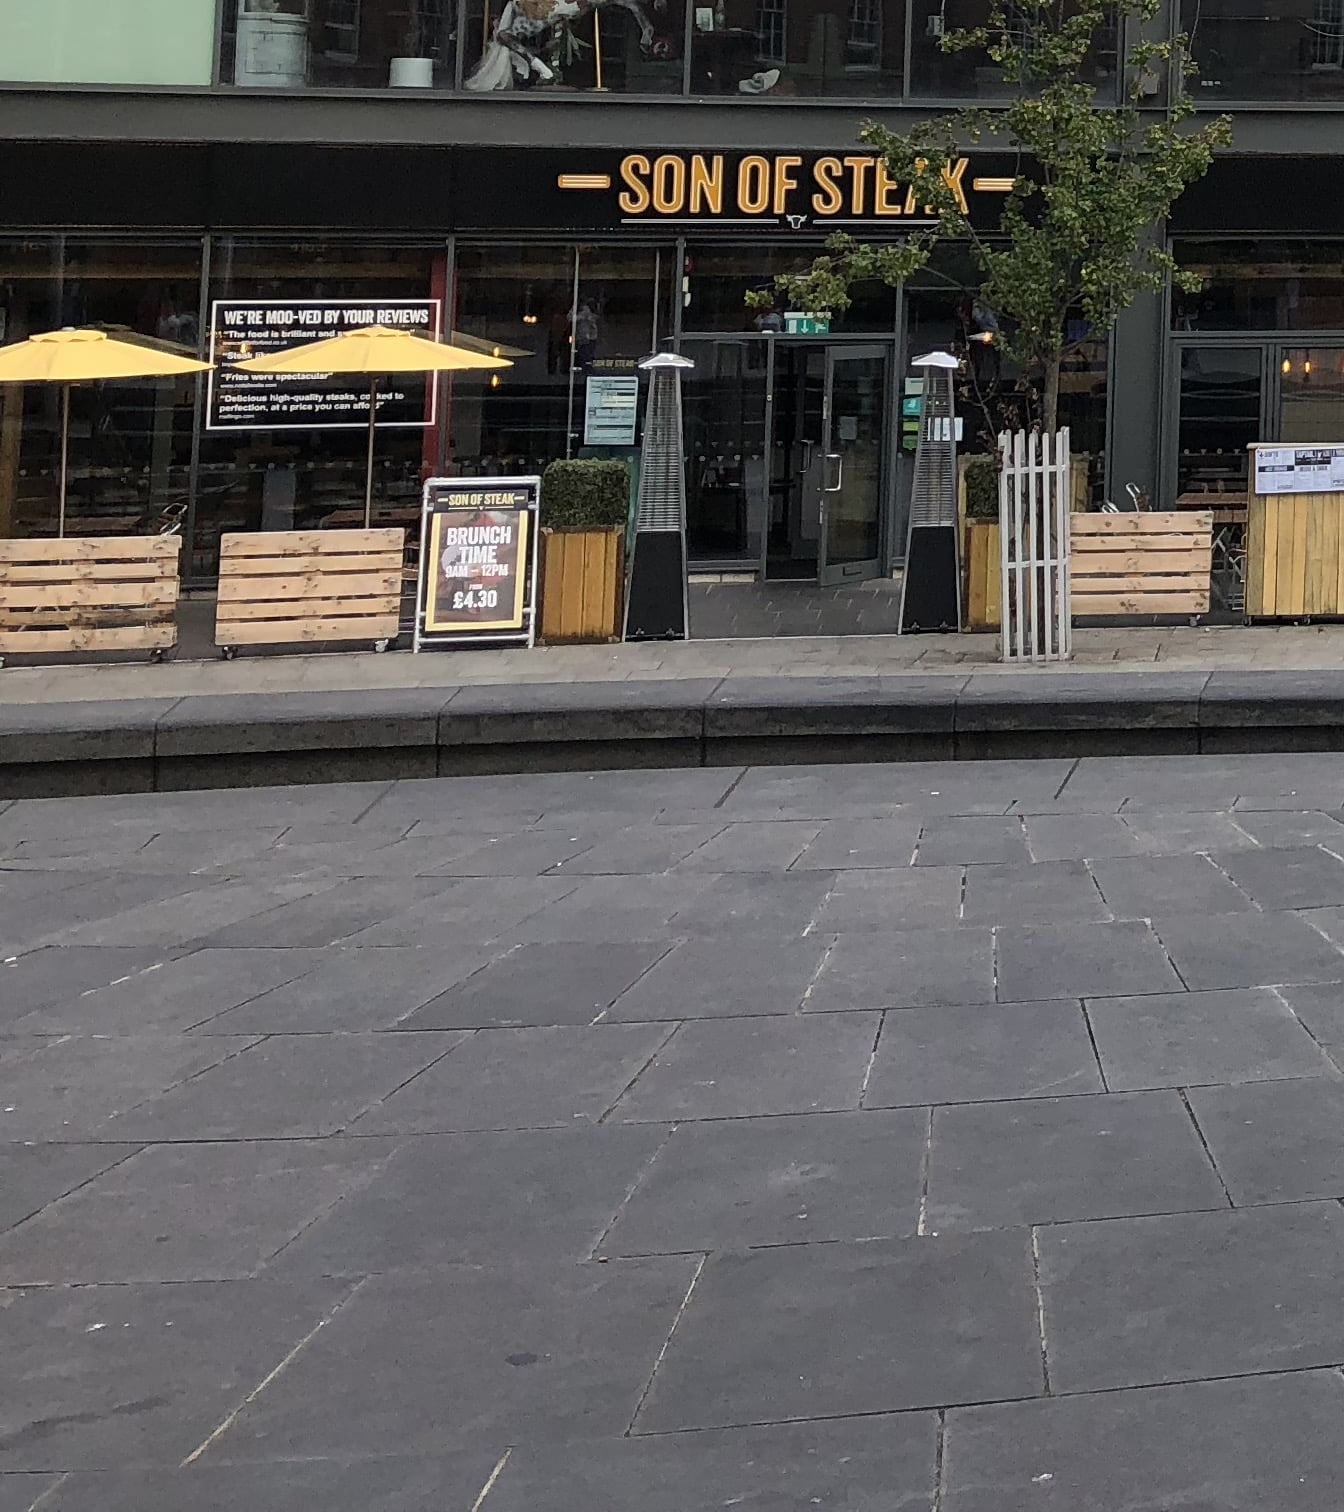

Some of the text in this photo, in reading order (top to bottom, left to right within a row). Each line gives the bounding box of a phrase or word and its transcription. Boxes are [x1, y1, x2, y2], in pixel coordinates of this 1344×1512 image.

[619, 154, 723, 214] SON
[737, 156, 802, 214] OF
[224, 309, 429, 325] WE'RE MOO-VED BY YOUR REVIEWS
[248, 330, 269, 338] food
[271, 330, 279, 338] is
[318, 329, 336, 337] and
[269, 393, 324, 403] high-quality
[325, 392, 358, 401] steaks,
[360, 392, 393, 400] coked
[394, 392, 405, 400] to
[219, 404, 269, 414] perfection,
[289, 403, 313, 412] price
[314, 404, 333, 412] you
[448, 492, 515, 506] SON OF STEAK
[447, 526, 512, 546] BRUNCH
[458, 545, 498, 564] TIME
[445, 565, 468, 578] 9AM
[481, 564, 508, 577] 12PM
[452, 589, 498, 609] £4.30
